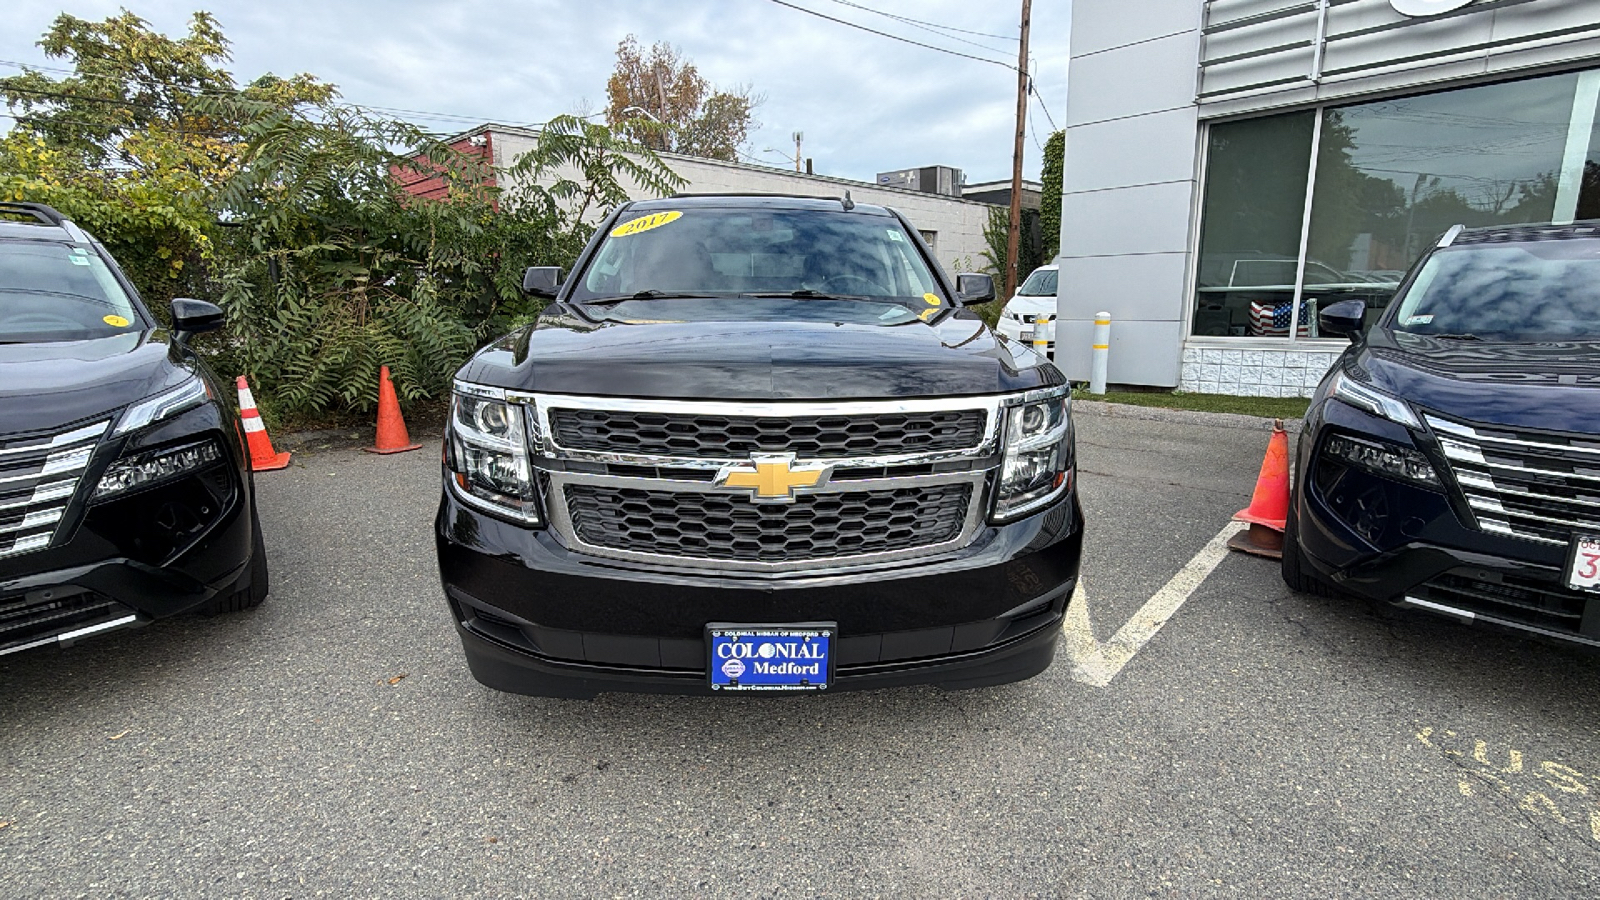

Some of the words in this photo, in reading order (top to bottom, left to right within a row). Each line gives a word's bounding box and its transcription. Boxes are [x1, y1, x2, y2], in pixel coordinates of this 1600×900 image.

[625, 213, 669, 234] 2017
[1578, 552, 1600, 580] 3
[717, 642, 825, 659] COLONIAL
[753, 661, 819, 675] Medford
